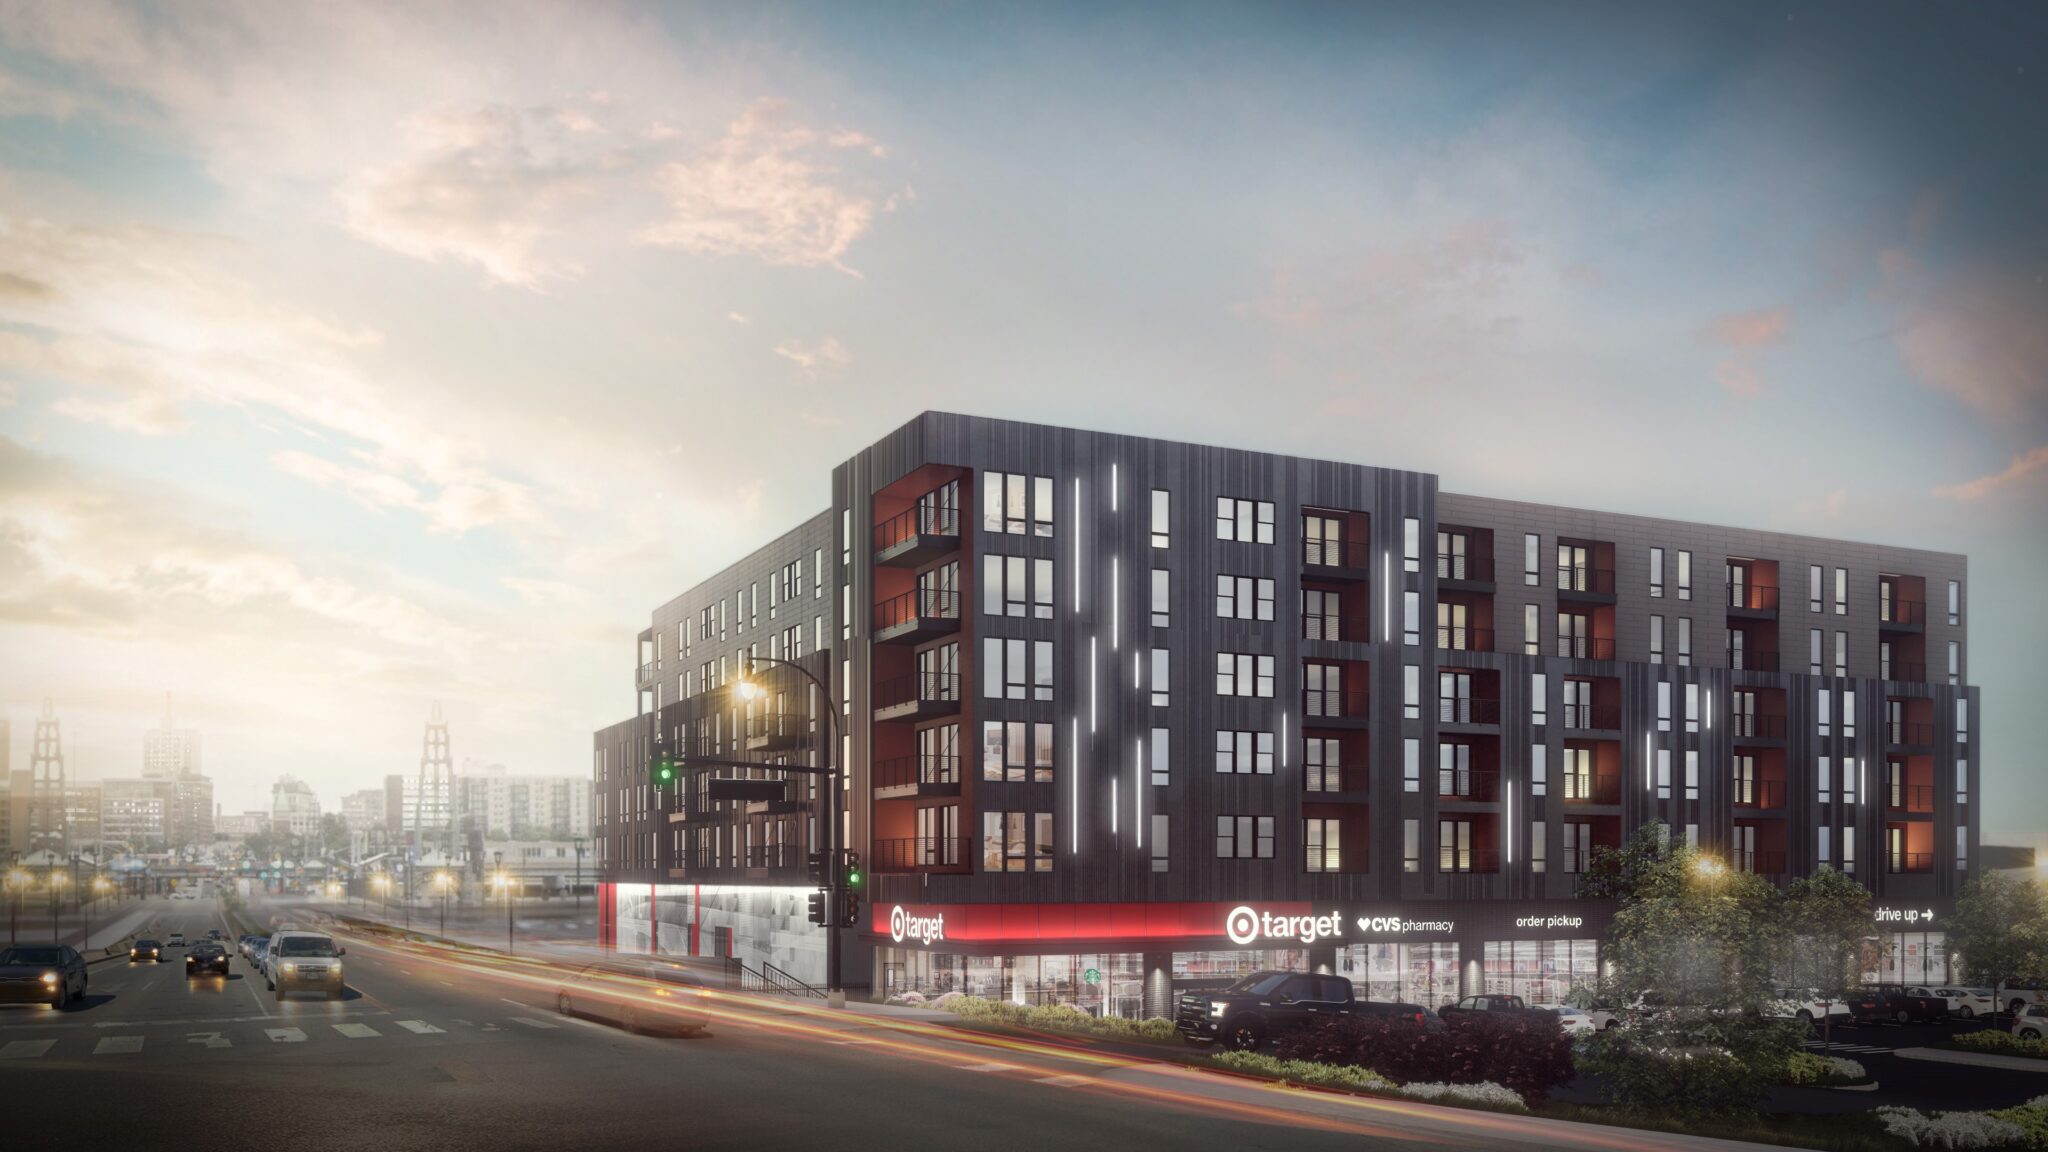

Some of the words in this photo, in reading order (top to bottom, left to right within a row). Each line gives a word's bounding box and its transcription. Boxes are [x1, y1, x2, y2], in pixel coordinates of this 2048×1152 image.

[1516, 915, 1545, 927] order
[1547, 915, 1582, 929] pickup
[1875, 907, 1901, 921] drive
[1904, 910, 1918, 924] up
[906, 911, 944, 945] target
[1262, 910, 1342, 943] target
[1371, 917, 1401, 932] CVS
[1402, 919, 1454, 934] pharmacy
